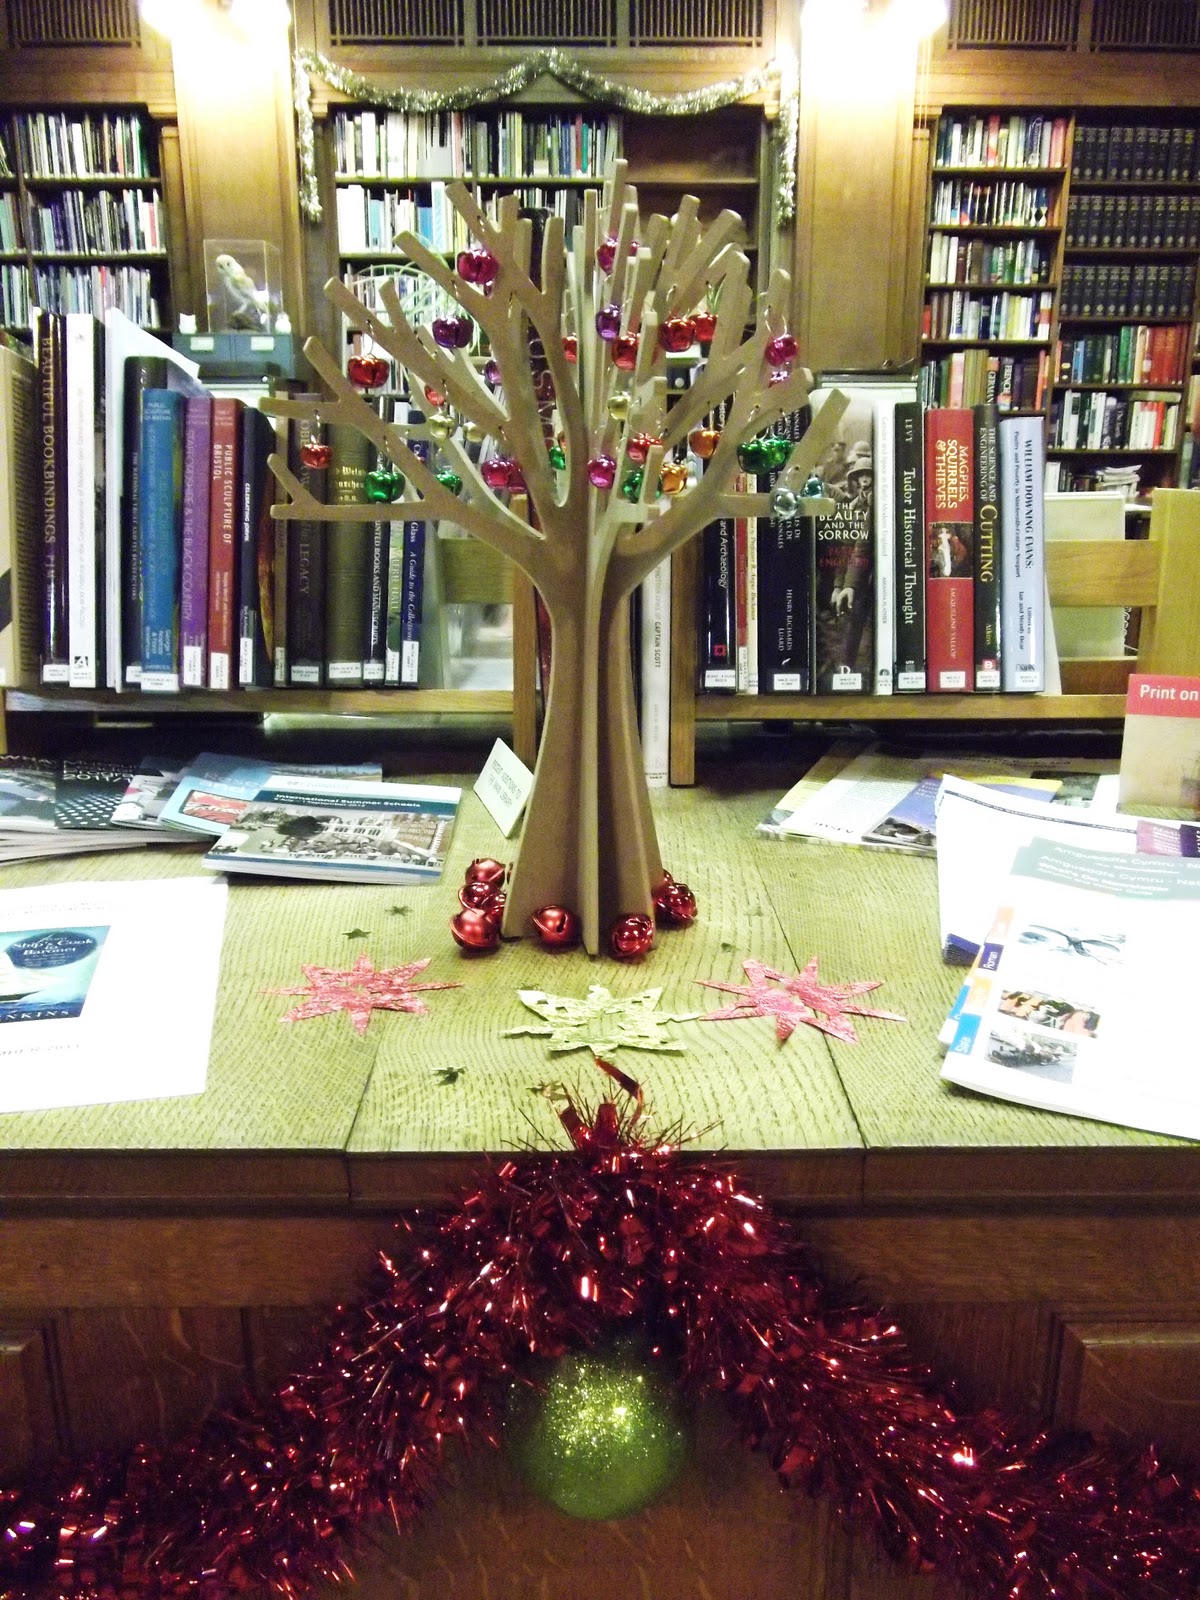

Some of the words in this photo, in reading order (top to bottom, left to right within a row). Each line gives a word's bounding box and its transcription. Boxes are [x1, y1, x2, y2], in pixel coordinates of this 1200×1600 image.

[41, 337, 53, 422] BEAUTIFUL
[987, 371, 996, 404] GERMAN
[1004, 365, 1013, 394] FRENCH
[905, 419, 913, 443] LEVY
[936, 440, 946, 452] &
[213, 444, 222, 480] BRISTOL
[224, 444, 233, 476] PUBLIC
[946, 439, 958, 509] SQUIRRELS
[958, 445, 969, 502] MAGPIES,
[980, 427, 988, 488] ENGINEERING
[1024, 439, 1034, 482] WILLIAM
[42, 426, 56, 544] BOOKBINDINGS
[904, 467, 916, 505] Tudor
[936, 454, 946, 509] THIEVES
[980, 489, 988, 502] OF
[224, 480, 233, 529] SCULPTURE
[1024, 485, 1034, 533] DOWNING
[223, 534, 232, 544] OF
[410, 522, 419, 543] Glass
[818, 530, 869, 540] SORROW
[903, 508, 916, 568] Historical
[980, 505, 998, 583] CUTTING
[184, 537, 194, 570] BLACK
[301, 543, 310, 594] LEGACY
[373, 547, 381, 574] BOOKS
[717, 537, 728, 589] Archaeology
[1024, 536, 1034, 569] EVANS:
[373, 575, 381, 591] AND
[409, 559, 417, 580] Guide
[183, 572, 193, 621] COUNTRY
[902, 572, 916, 625] Thought
[949, 588, 957, 630] JACQUELINE
[1140, 684, 1175, 699] Print
[1180, 690, 1198, 700] on
[276, 794, 339, 804] International
[1119, 873, 1164, 884] Cymru
[1131, 858, 1175, 868] Cymru
[0, 1010, 69, 1020] NKINS
